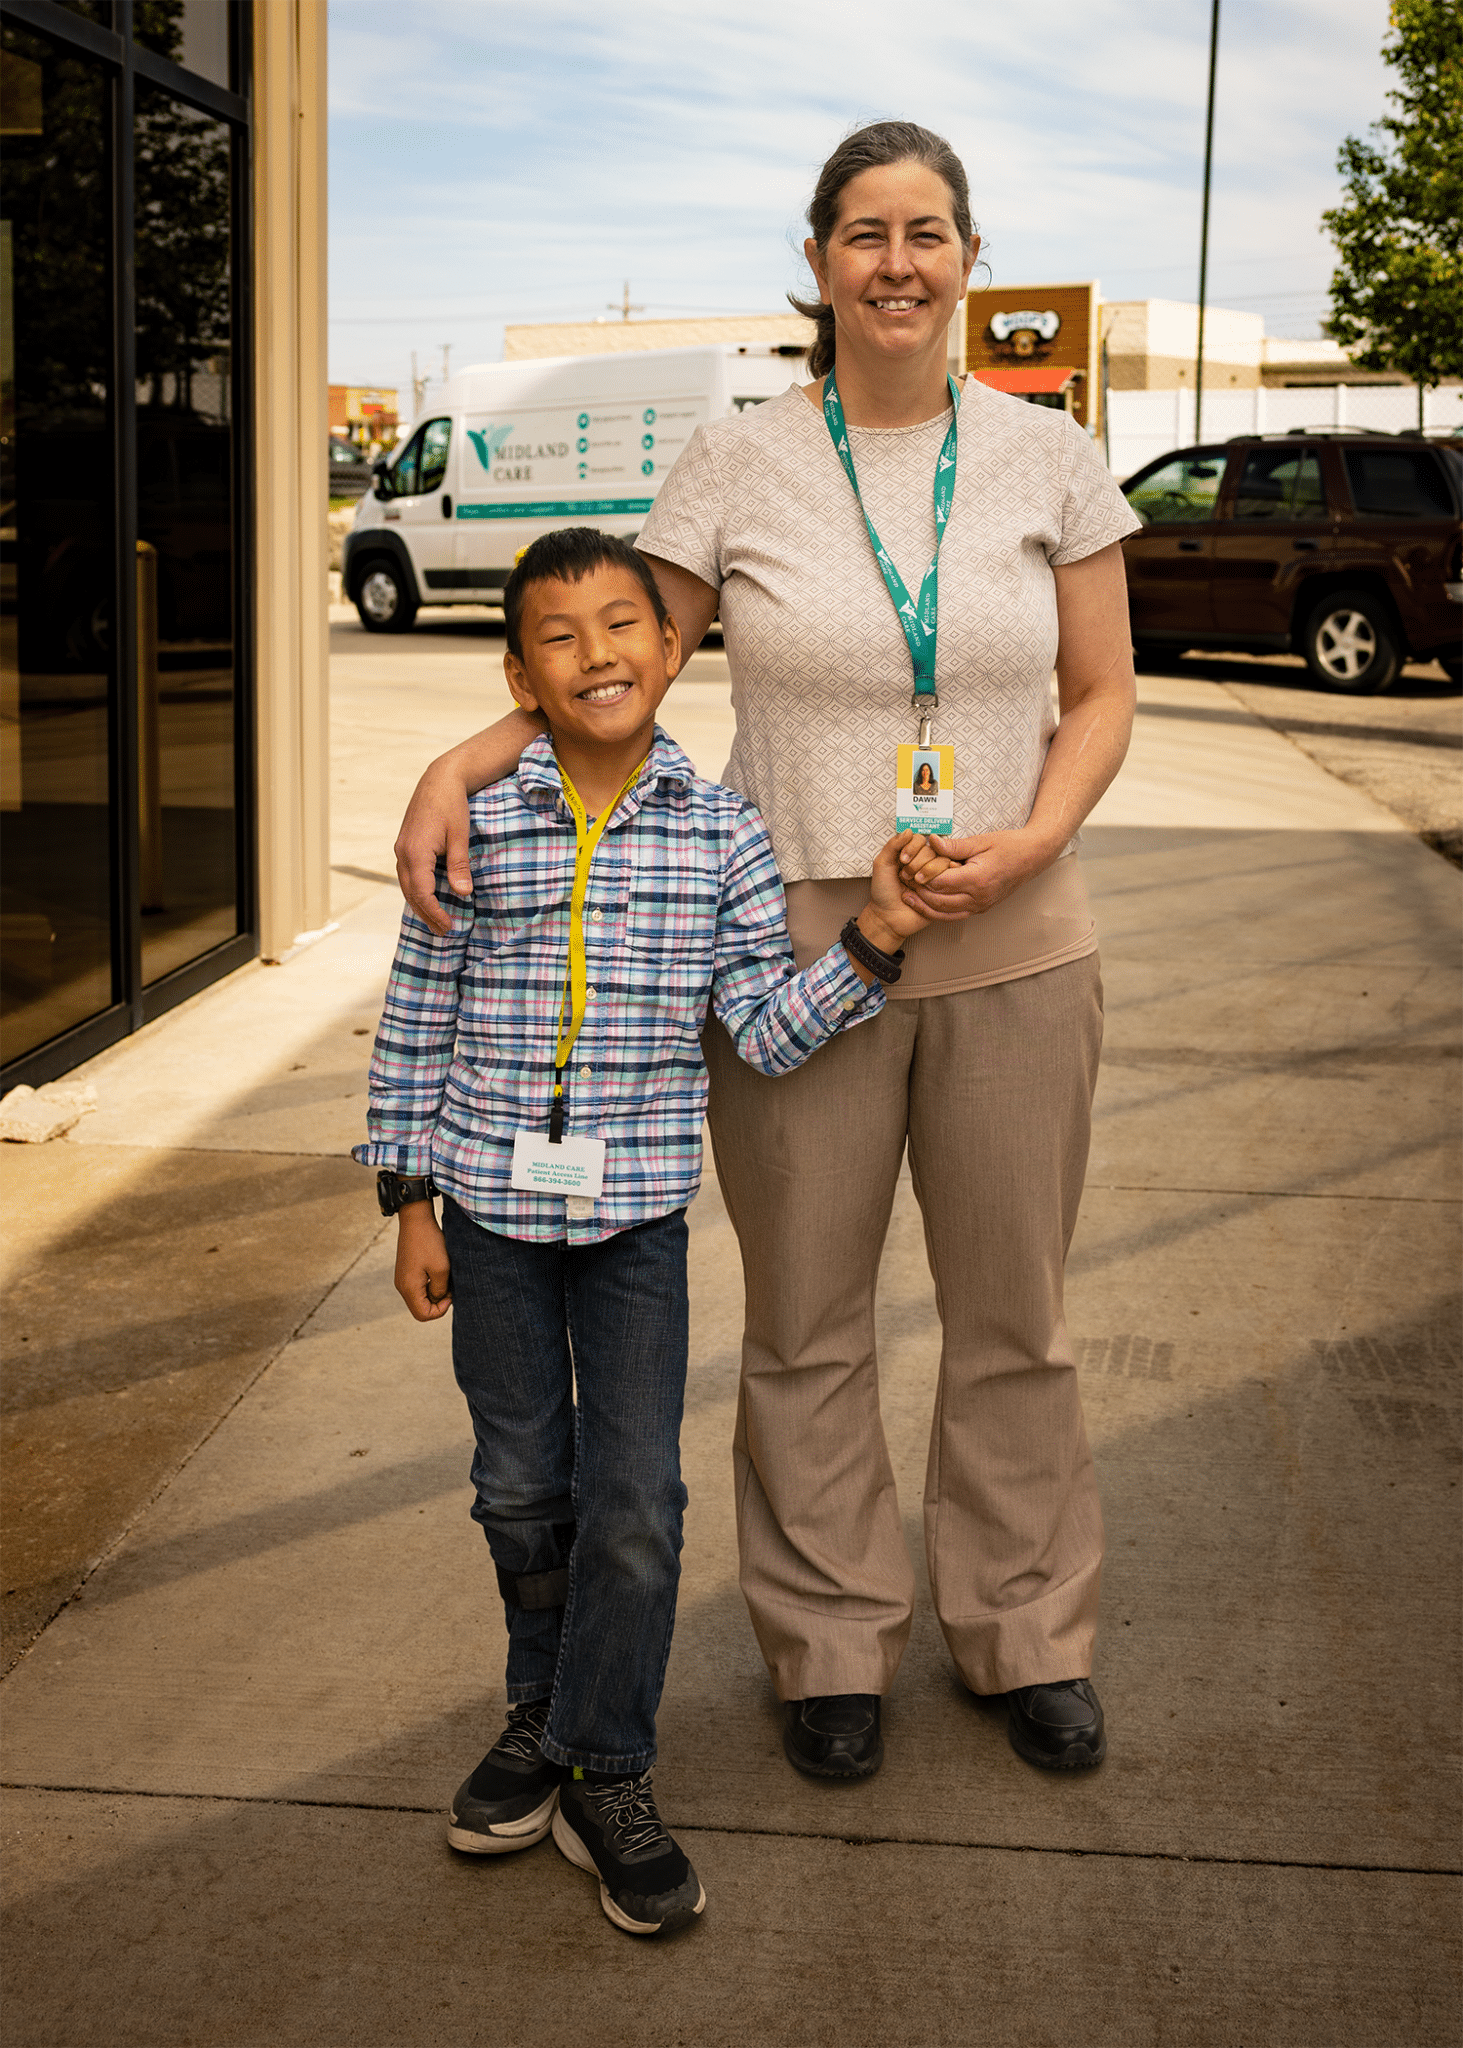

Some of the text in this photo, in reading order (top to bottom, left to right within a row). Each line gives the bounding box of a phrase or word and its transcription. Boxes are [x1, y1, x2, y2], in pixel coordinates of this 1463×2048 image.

[494, 442, 570, 461] MIDLAND
[493, 465, 533, 482] CARE
[901, 616, 911, 633] CARE
[907, 615, 921, 647] MIDLAND
[527, 1168, 550, 1176] Patient
[552, 1170, 573, 1178] Access
[532, 1162, 586, 1172] MIDLAND CARE
